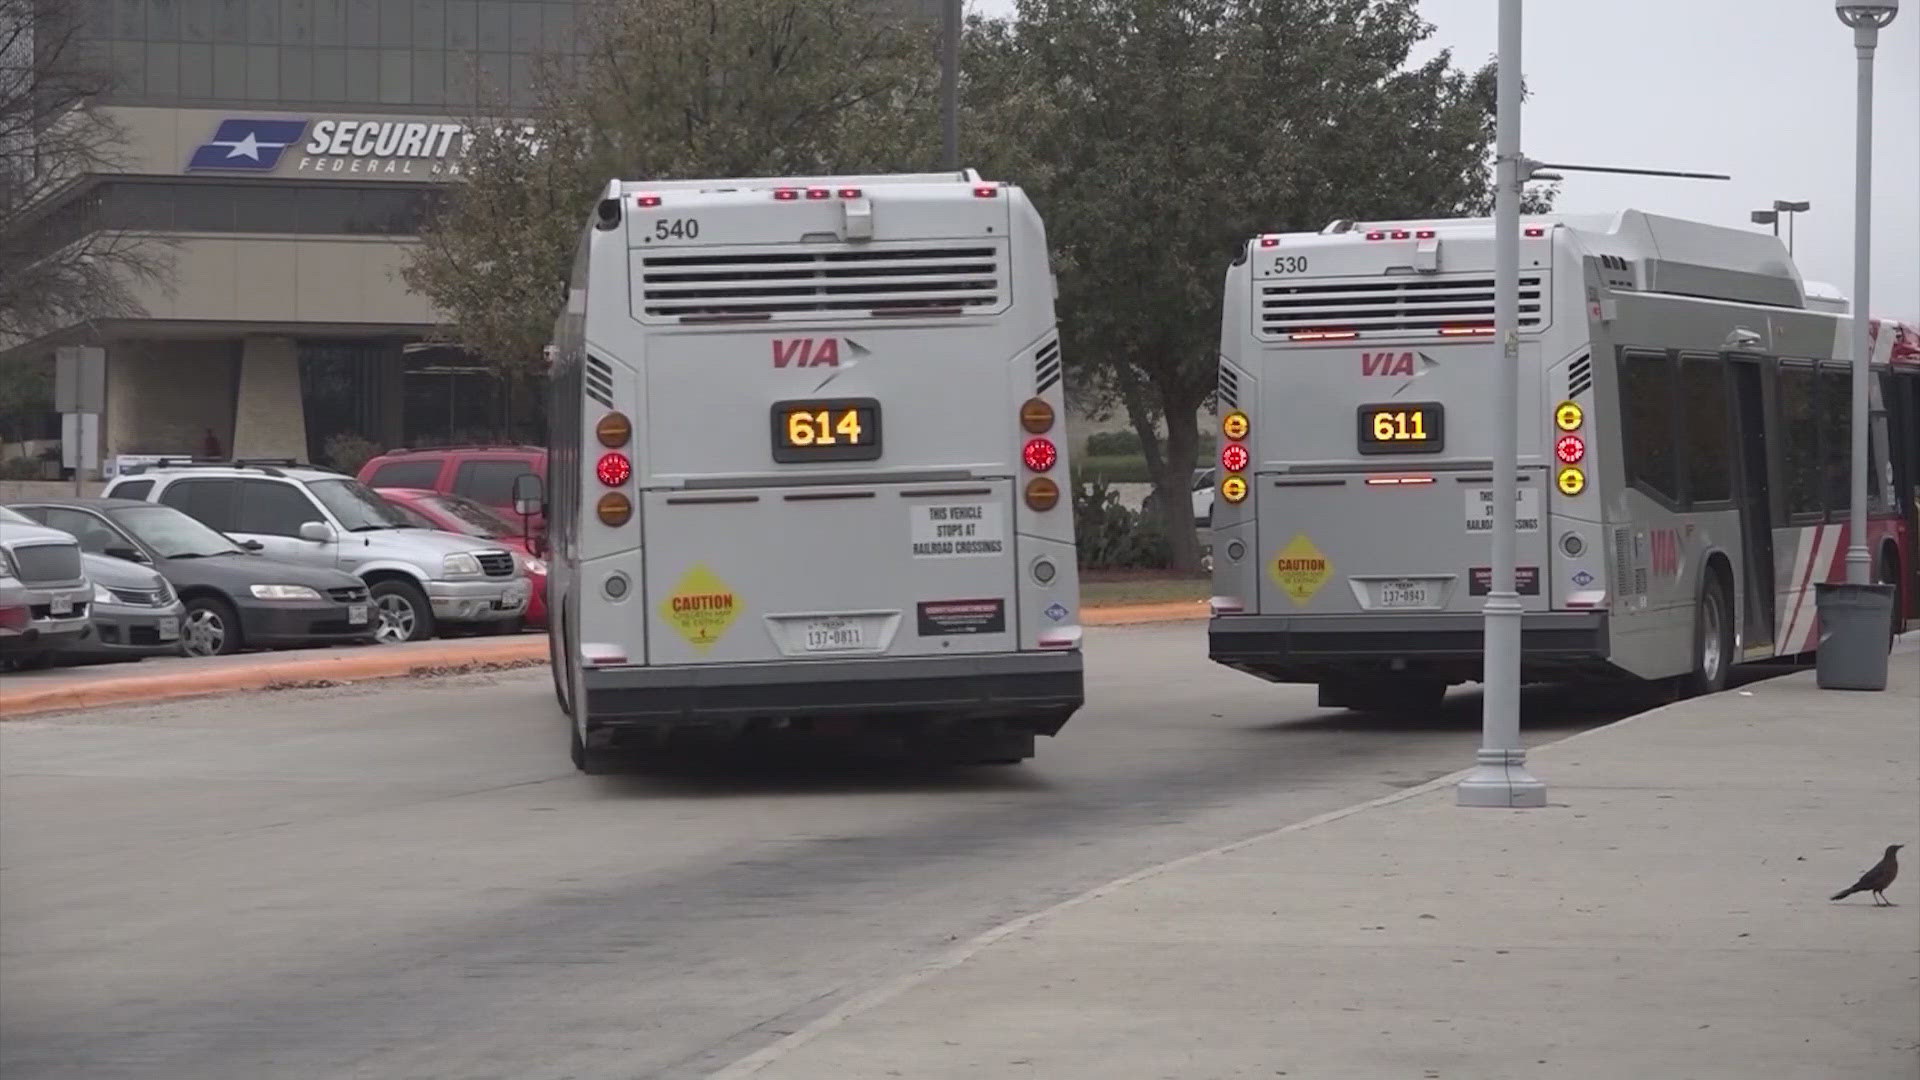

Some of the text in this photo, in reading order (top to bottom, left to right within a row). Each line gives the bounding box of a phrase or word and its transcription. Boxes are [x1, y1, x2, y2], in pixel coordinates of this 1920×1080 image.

[298, 157, 412, 174] FEDERAL
[656, 218, 699, 240] 540
[1274, 255, 1308, 274] 530
[772, 338, 839, 368] VIA
[1362, 352, 1415, 377] VIA
[789, 409, 862, 446] 614
[1373, 411, 1427, 441] 611
[929, 505, 982, 520] THIS VEHICLE
[937, 522, 976, 538] STOPS AT
[913, 540, 1003, 555] RAILROAD CROSSINGS
[1278, 559, 1325, 572] CAUTION
[672, 594, 733, 612] CAUTION
